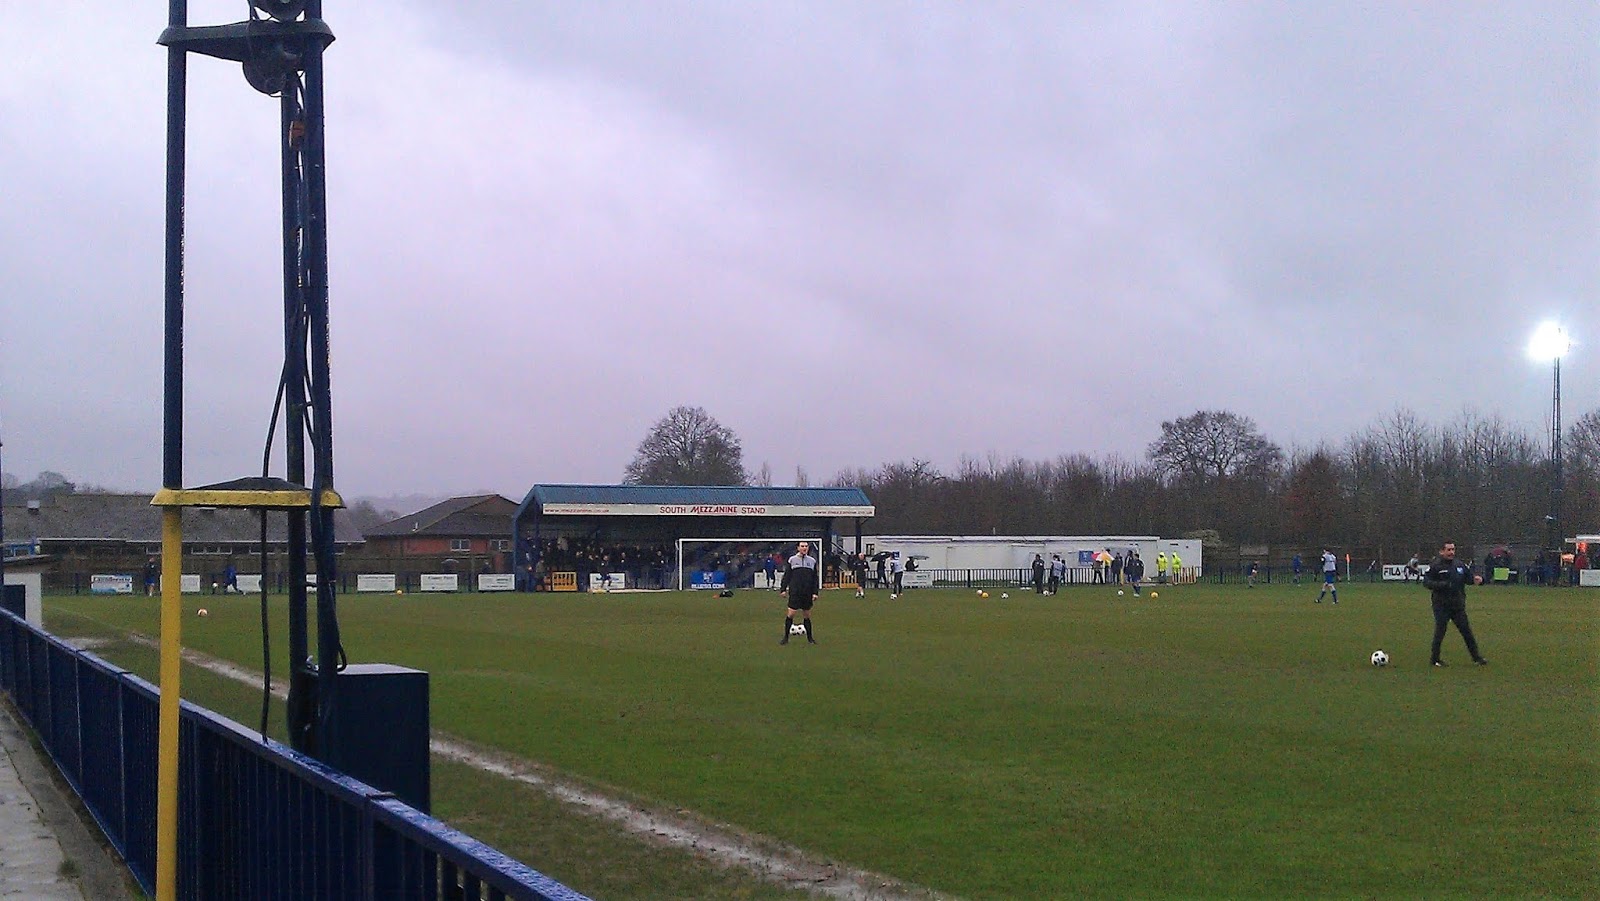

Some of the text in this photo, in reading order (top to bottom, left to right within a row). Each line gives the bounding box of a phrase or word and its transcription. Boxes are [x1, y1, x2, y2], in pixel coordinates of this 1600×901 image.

[659, 506, 766, 515] SOUTH MEZZANINE STAND
[1383, 567, 1401, 576] FILA
